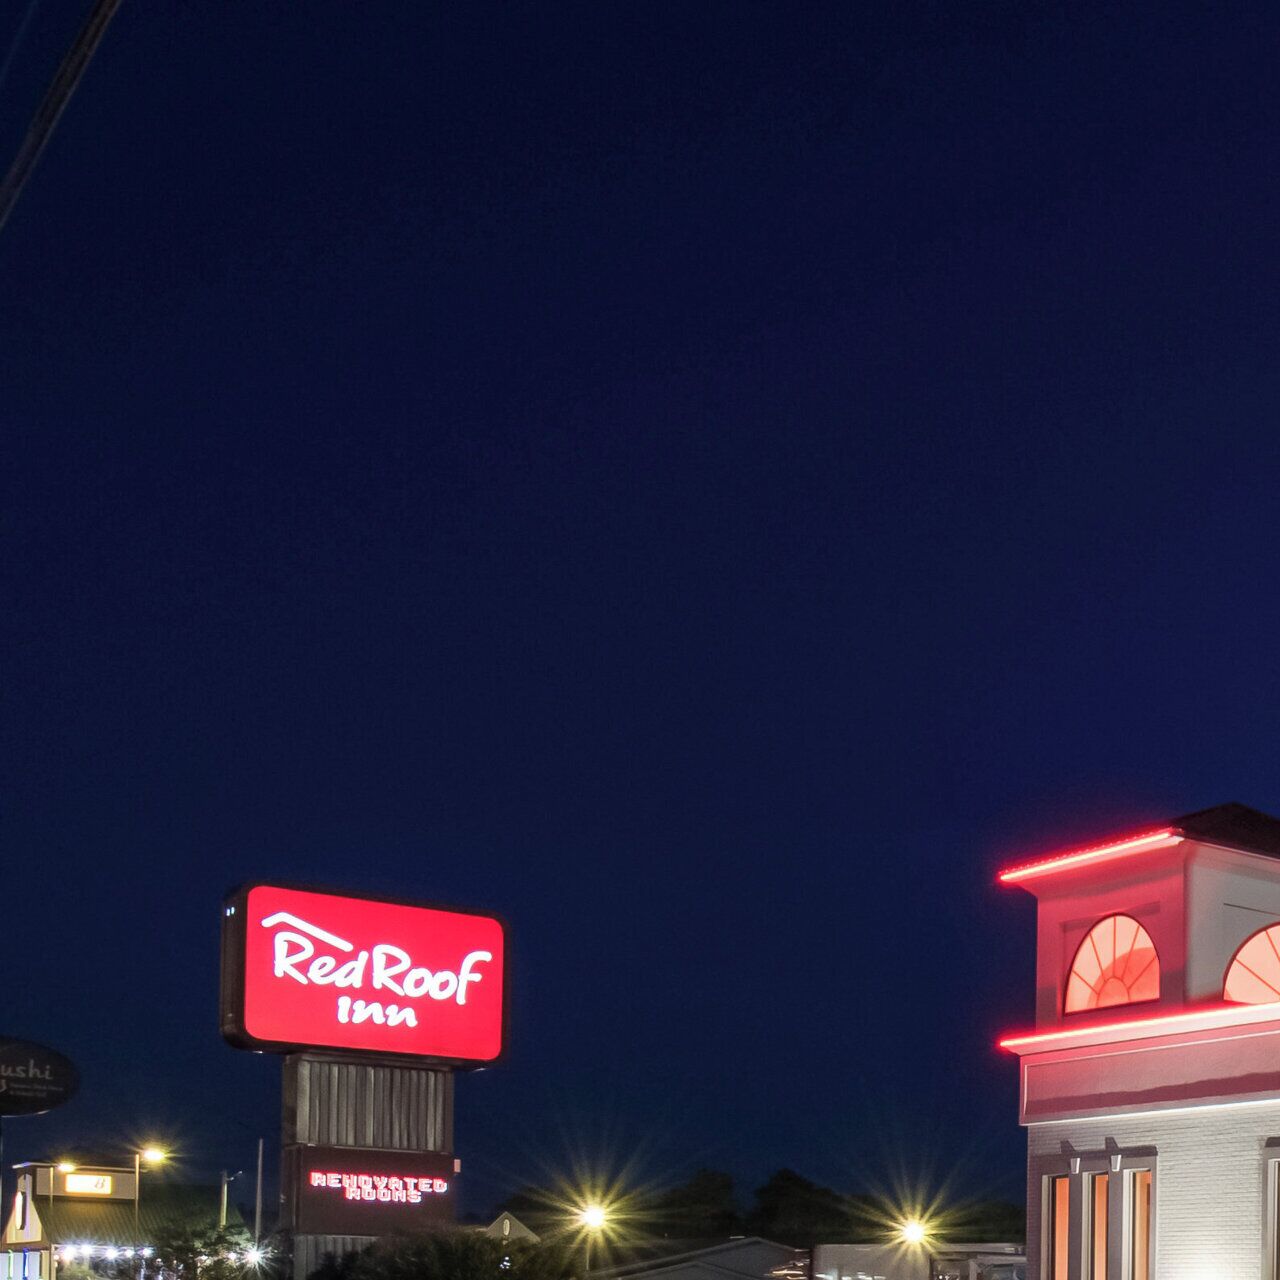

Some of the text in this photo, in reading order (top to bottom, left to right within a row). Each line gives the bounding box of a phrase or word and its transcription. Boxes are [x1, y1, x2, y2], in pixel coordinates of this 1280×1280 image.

[274, 931, 492, 1004] Red Roof
[310, 1172, 449, 1193] RENOVATED
[345, 1186, 422, 1203] ROOMS
